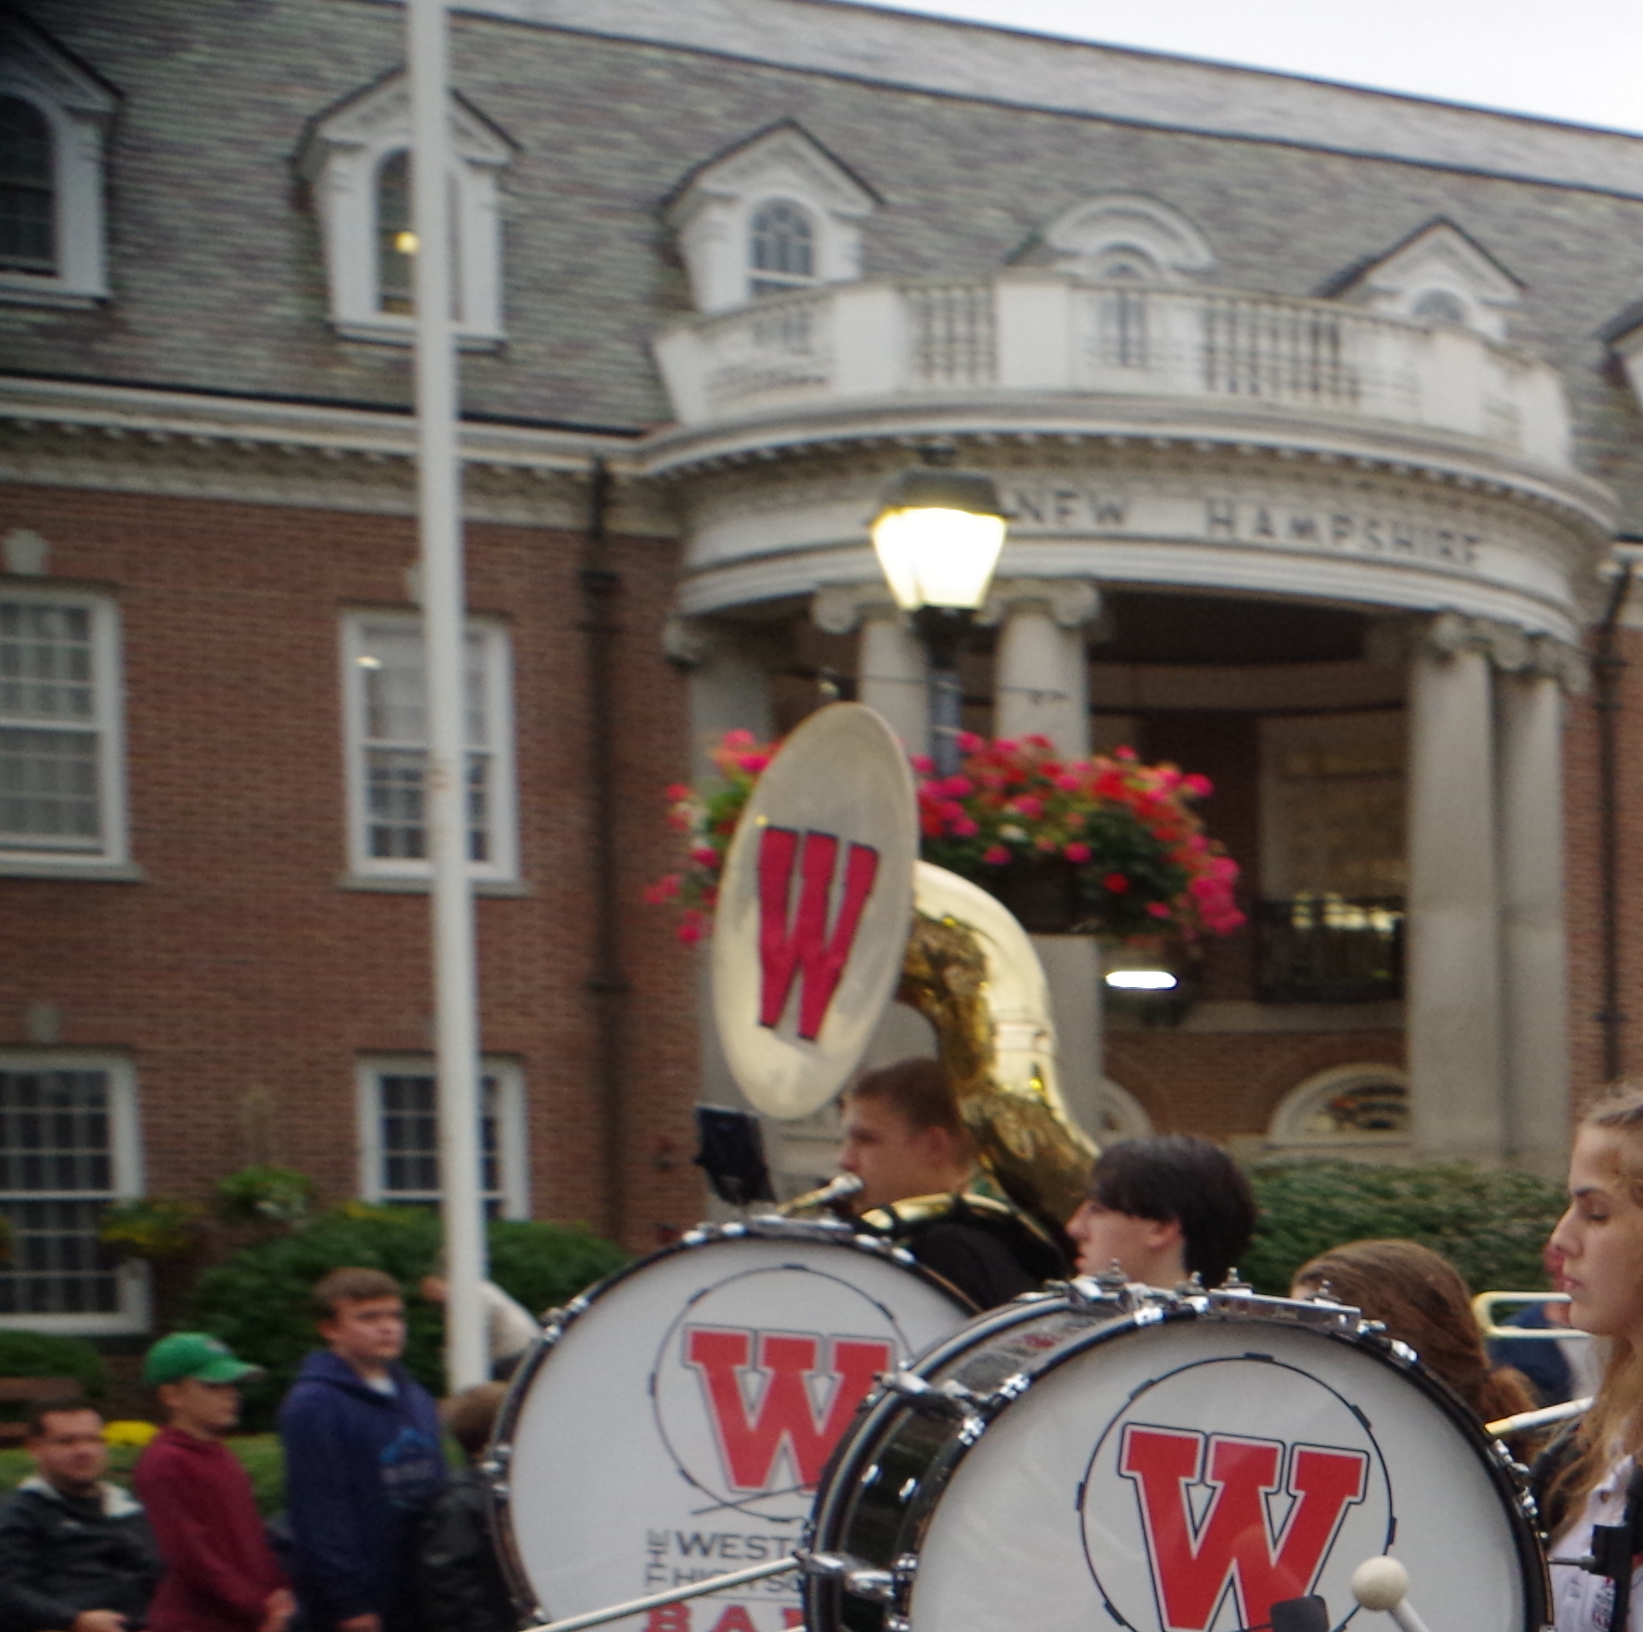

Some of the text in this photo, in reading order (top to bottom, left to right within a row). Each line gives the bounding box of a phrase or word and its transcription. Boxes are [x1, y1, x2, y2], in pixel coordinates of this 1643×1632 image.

[1014, 487, 1482, 567] NEW HAMPSHIRE
[757, 824, 879, 1042] W
[682, 1323, 896, 1497] W
